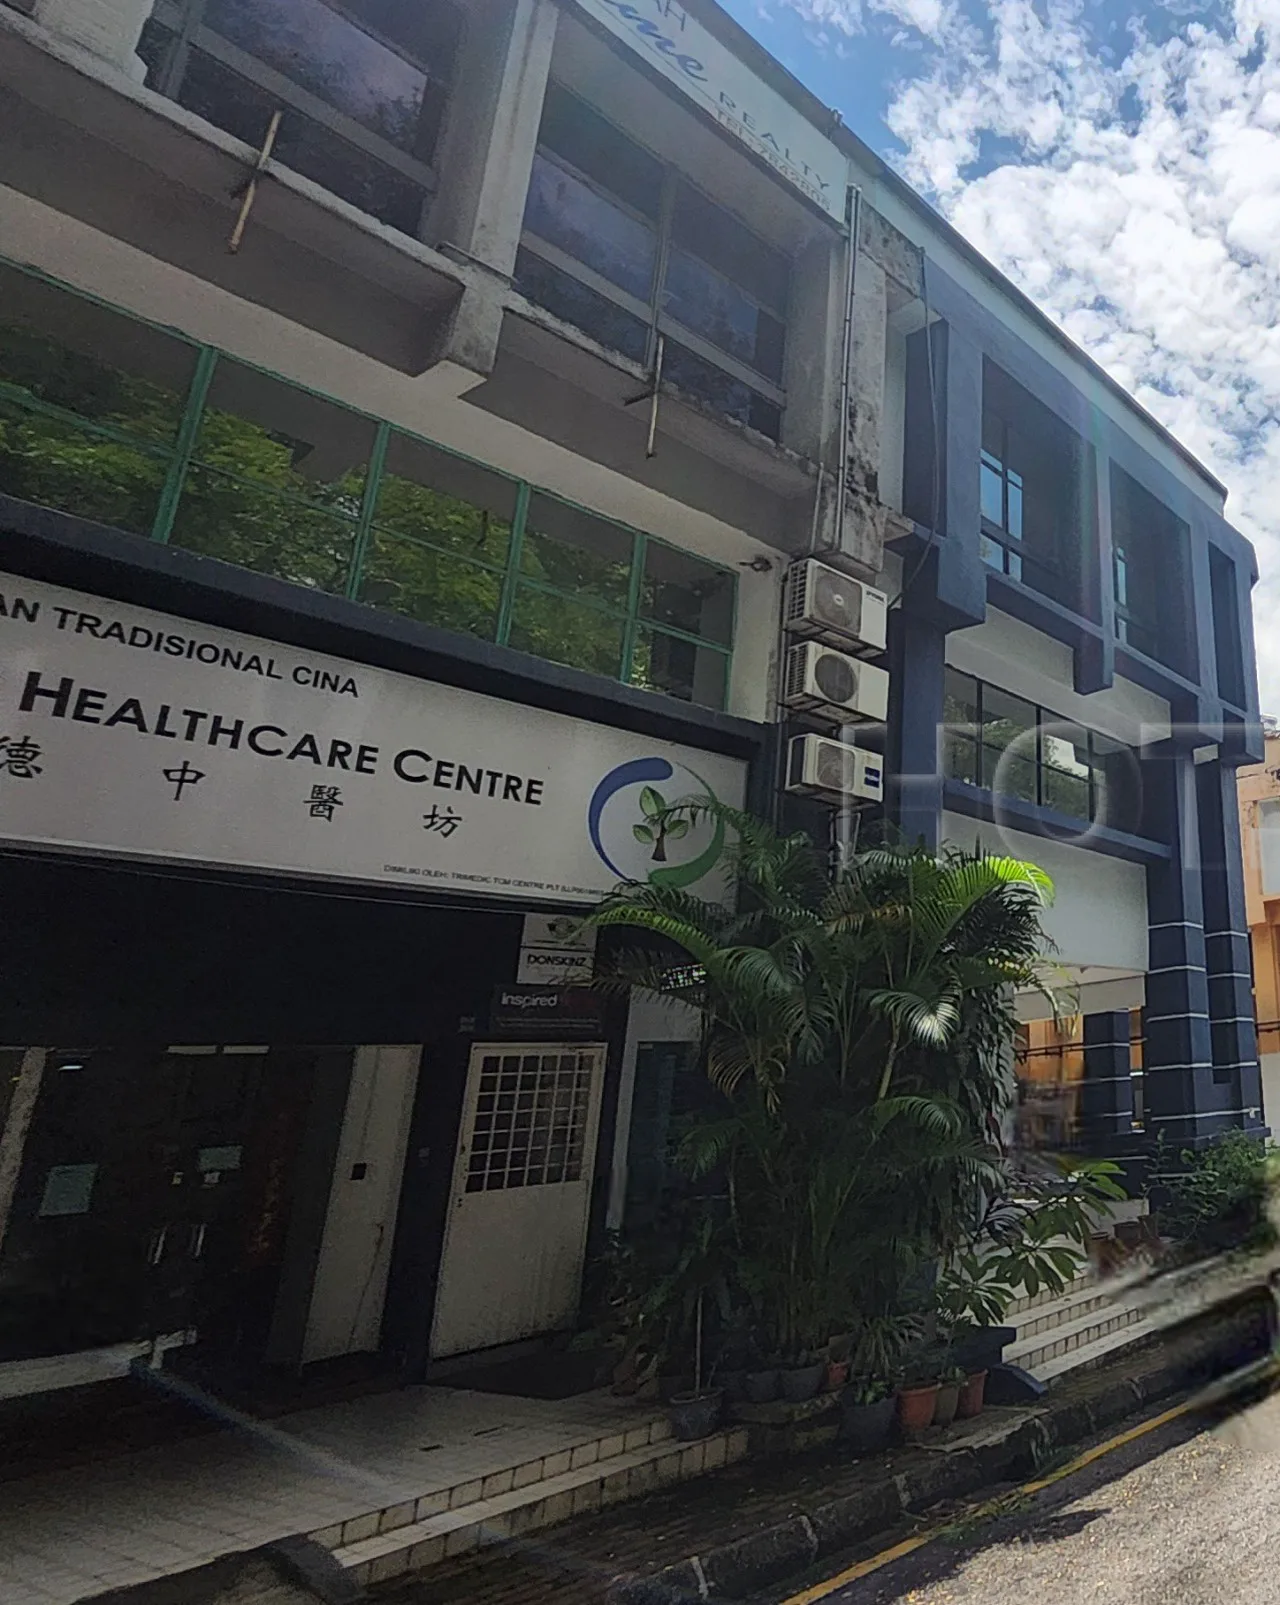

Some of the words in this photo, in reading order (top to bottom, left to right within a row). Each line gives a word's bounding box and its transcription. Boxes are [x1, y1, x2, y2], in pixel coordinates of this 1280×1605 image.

[720, 91, 830, 189] REALTY
[52, 606, 284, 680] TRADISIONAL
[292, 665, 359, 698] CINA
[500, 992, 558, 1010] inspired
